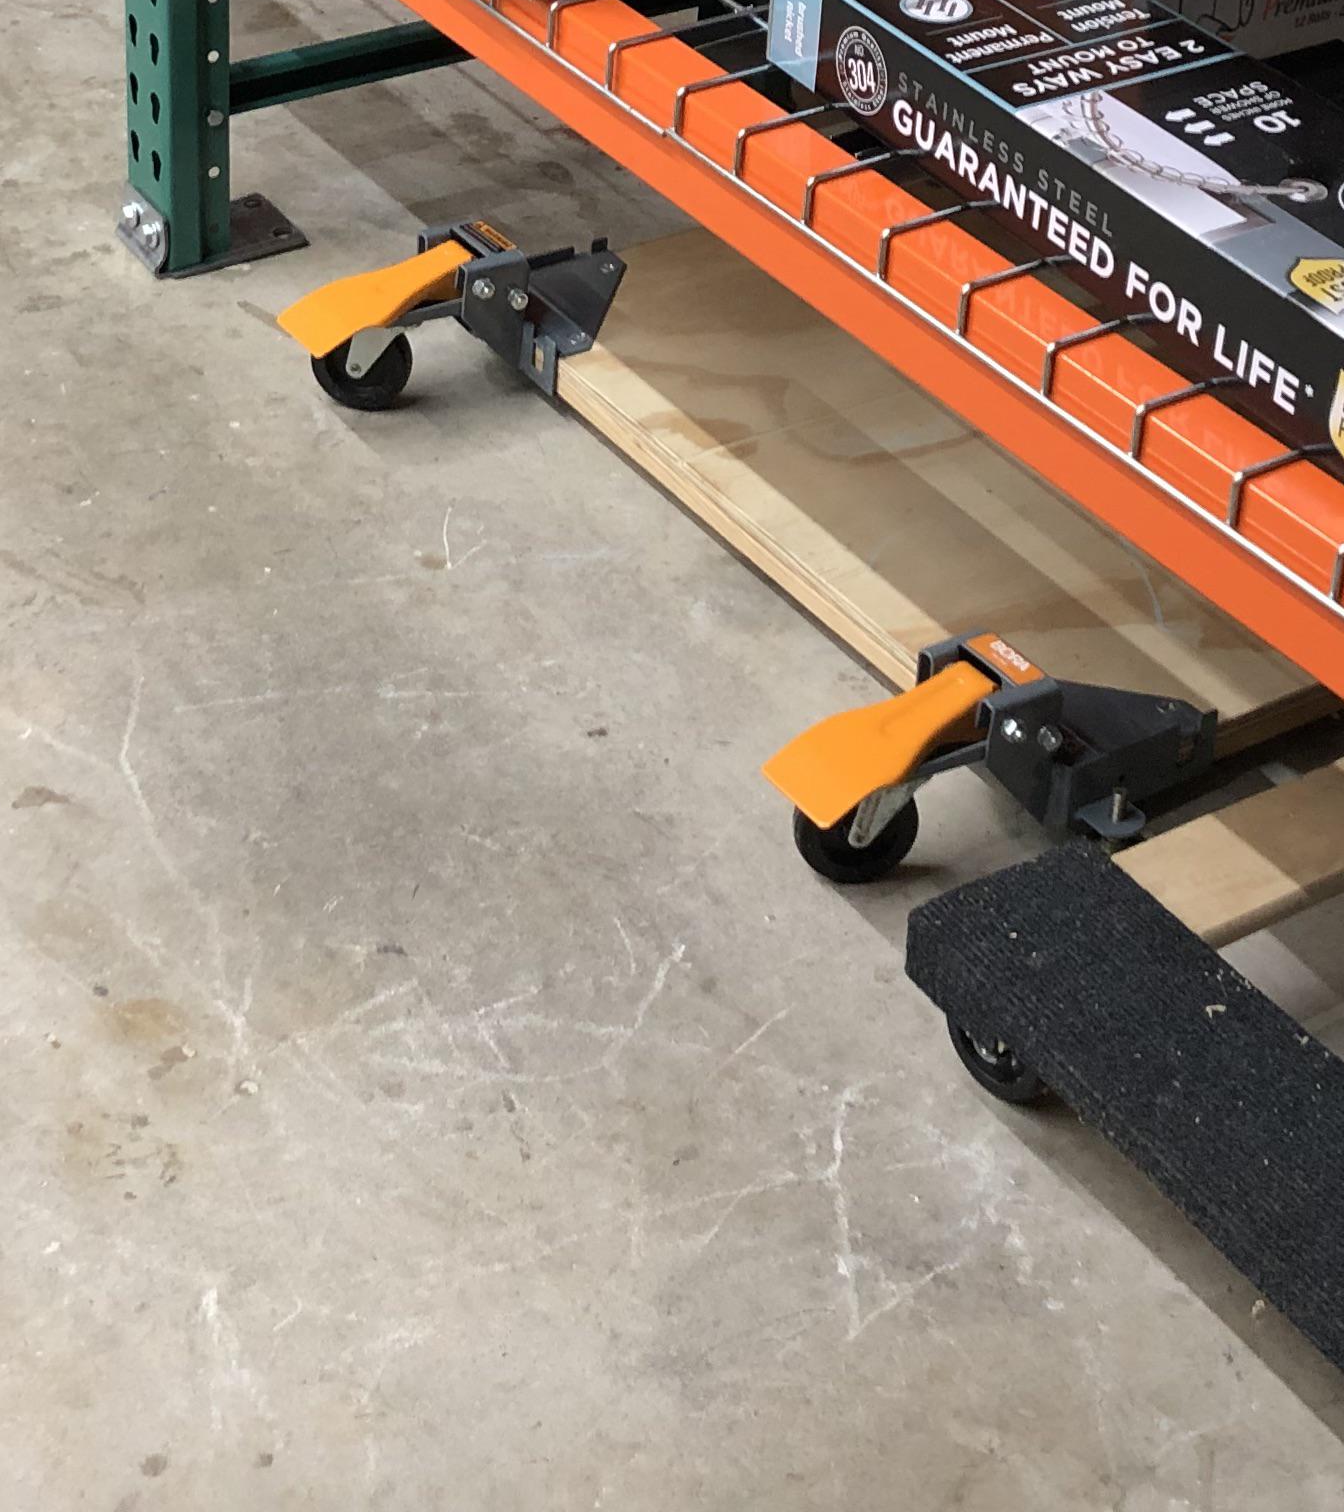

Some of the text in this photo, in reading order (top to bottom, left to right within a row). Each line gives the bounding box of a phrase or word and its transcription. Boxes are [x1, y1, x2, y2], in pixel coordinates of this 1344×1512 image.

[946, 23, 1017, 48] Mount
[1070, 8, 1151, 33] Tension
[945, 31, 1054, 64] Permanent
[1027, 36, 1154, 76] TO MOUNT
[848, 58, 876, 93] 304
[1012, 39, 1205, 97] 2 EASY WAYS
[1192, 81, 1269, 108] SPACE
[1253, 110, 1302, 133] 10
[897, 71, 1113, 238] STAINLESS STEEL
[892, 99, 1115, 279] GUARANTEED
[1125, 261, 1203, 347] FOR
